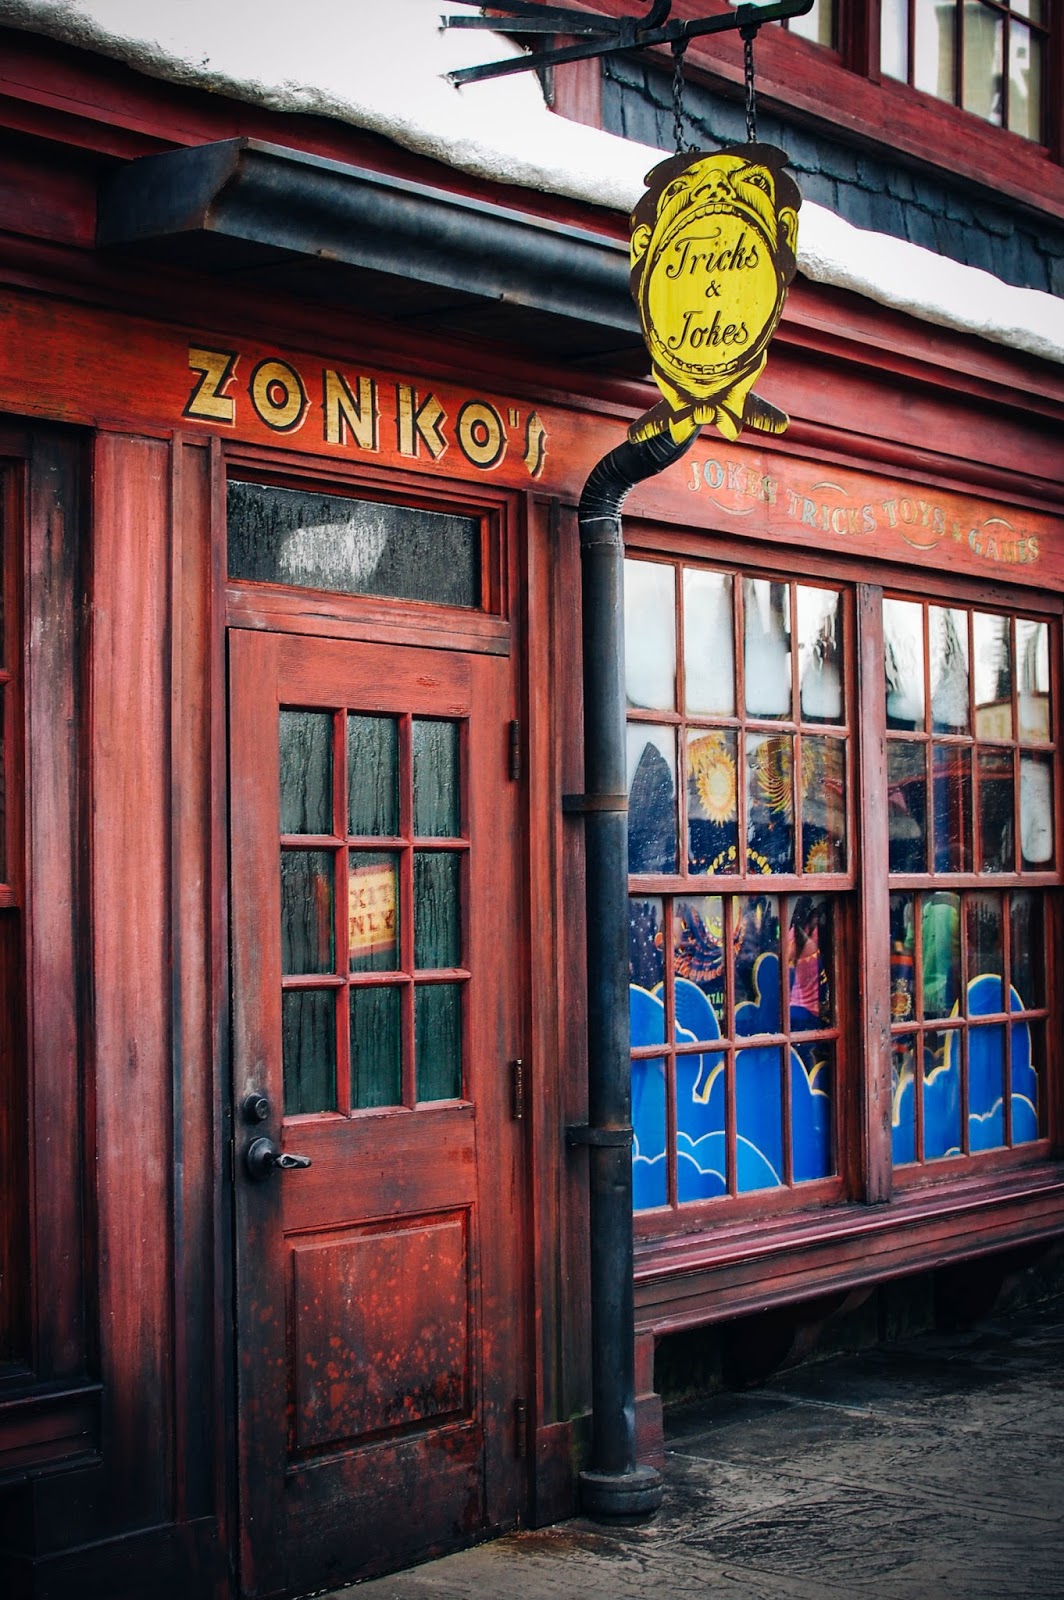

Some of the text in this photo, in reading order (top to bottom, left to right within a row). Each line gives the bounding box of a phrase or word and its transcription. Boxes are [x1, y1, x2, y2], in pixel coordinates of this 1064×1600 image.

[665, 227, 760, 281] Tricks
[704, 279, 722, 299] &
[667, 310, 749, 350] Jokes
[181, 345, 550, 482] ZONKO'S
[687, 458, 779, 506] JOKES
[785, 488, 877, 536] TRICKS
[882, 498, 946, 536] TOYS
[967, 527, 1040, 565] GAMES
[349, 882, 391, 910] XIT
[349, 909, 394, 937] NLY
